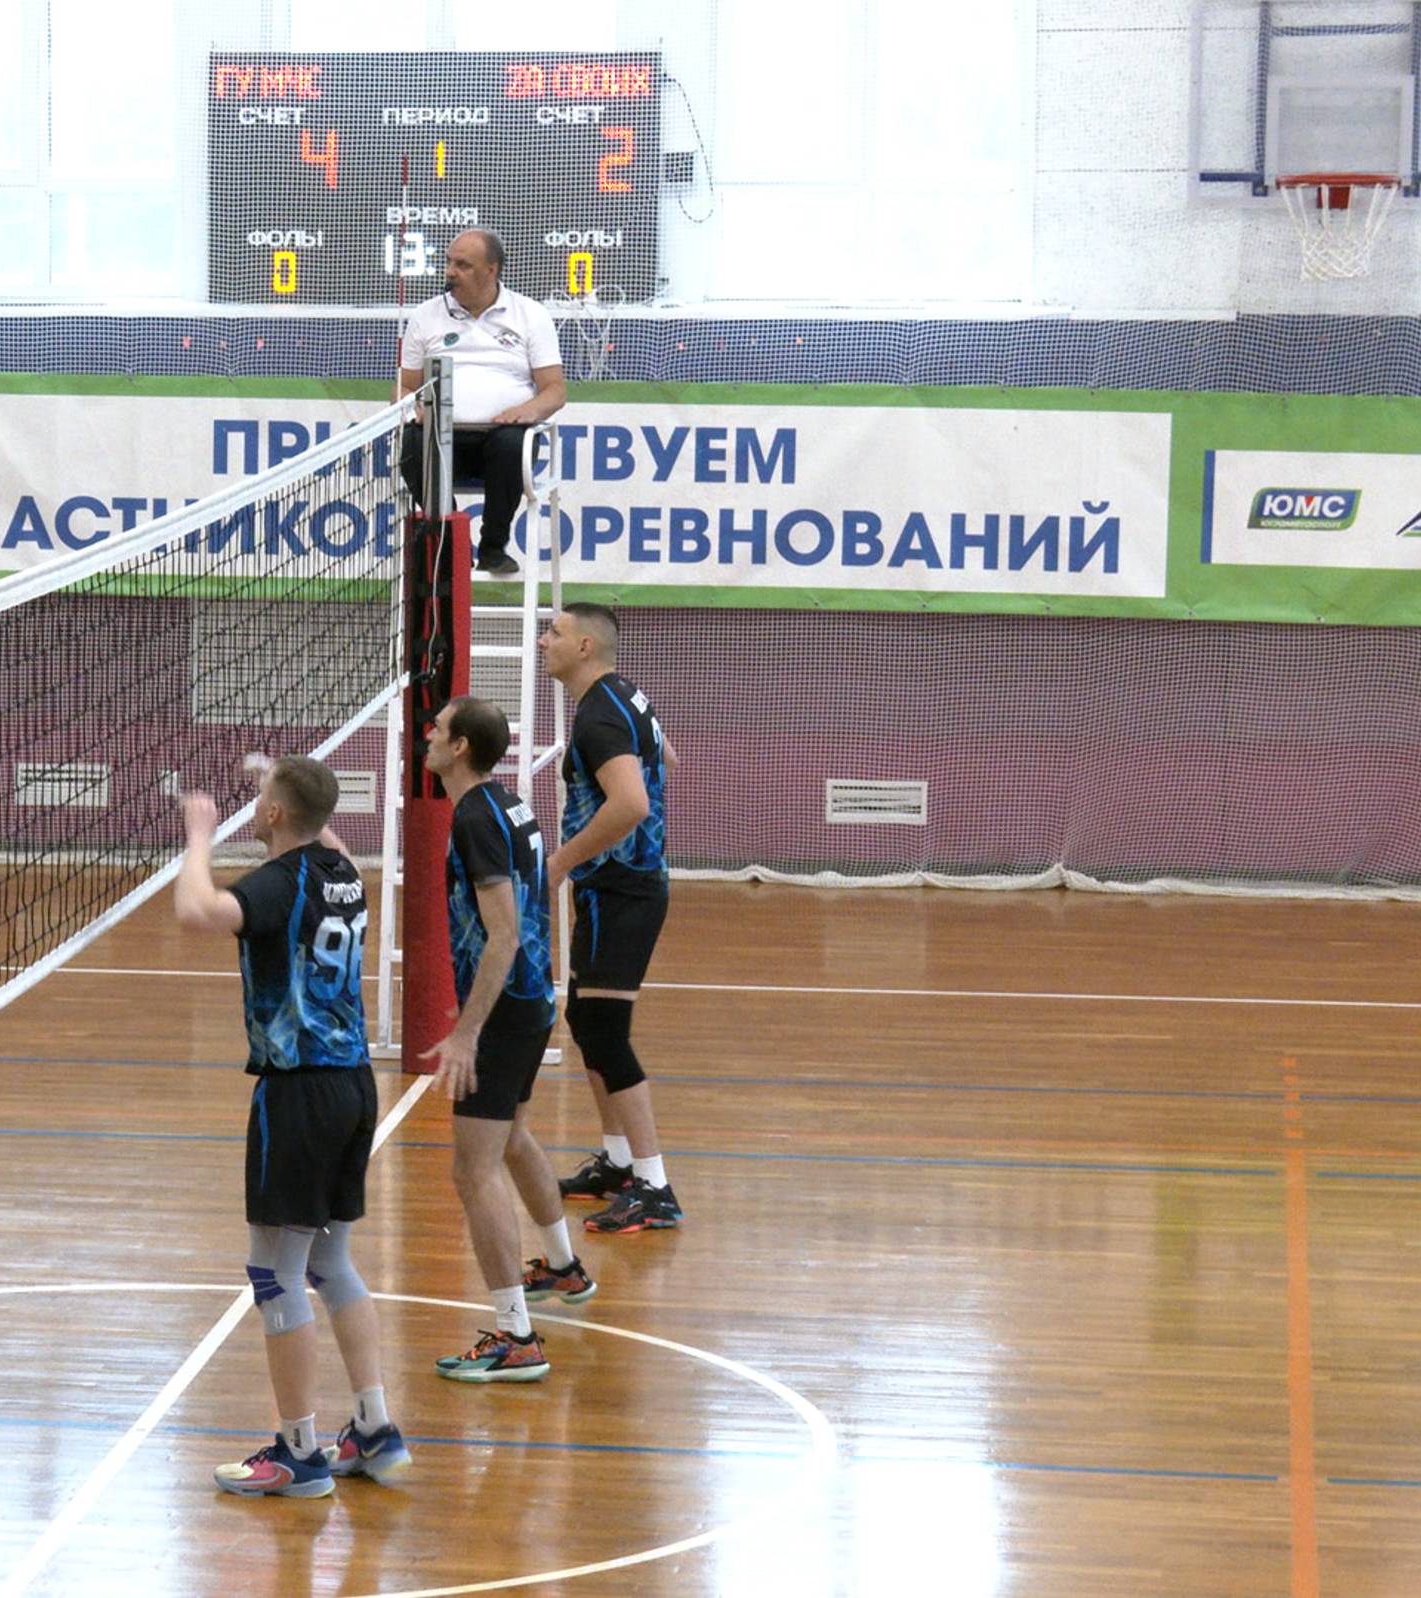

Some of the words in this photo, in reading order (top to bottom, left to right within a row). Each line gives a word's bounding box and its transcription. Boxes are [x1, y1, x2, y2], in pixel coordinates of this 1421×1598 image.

[238, 107, 307, 125] СЧЕТ
[382, 107, 490, 125] ПЕРИОД
[536, 106, 605, 125] СЧЕТ
[301, 129, 338, 189] 4
[436, 140, 445, 178] 1
[598, 127, 634, 192] 2
[386, 207, 478, 225] ВРЕМЯ
[247, 230, 323, 248] ФОЛЫ
[545, 230, 622, 247] ФОЛЫ
[273, 251, 297, 292] 0
[213, 419, 797, 485] ПРТВУЕМ
[1262, 494, 1346, 518] ЮМС
